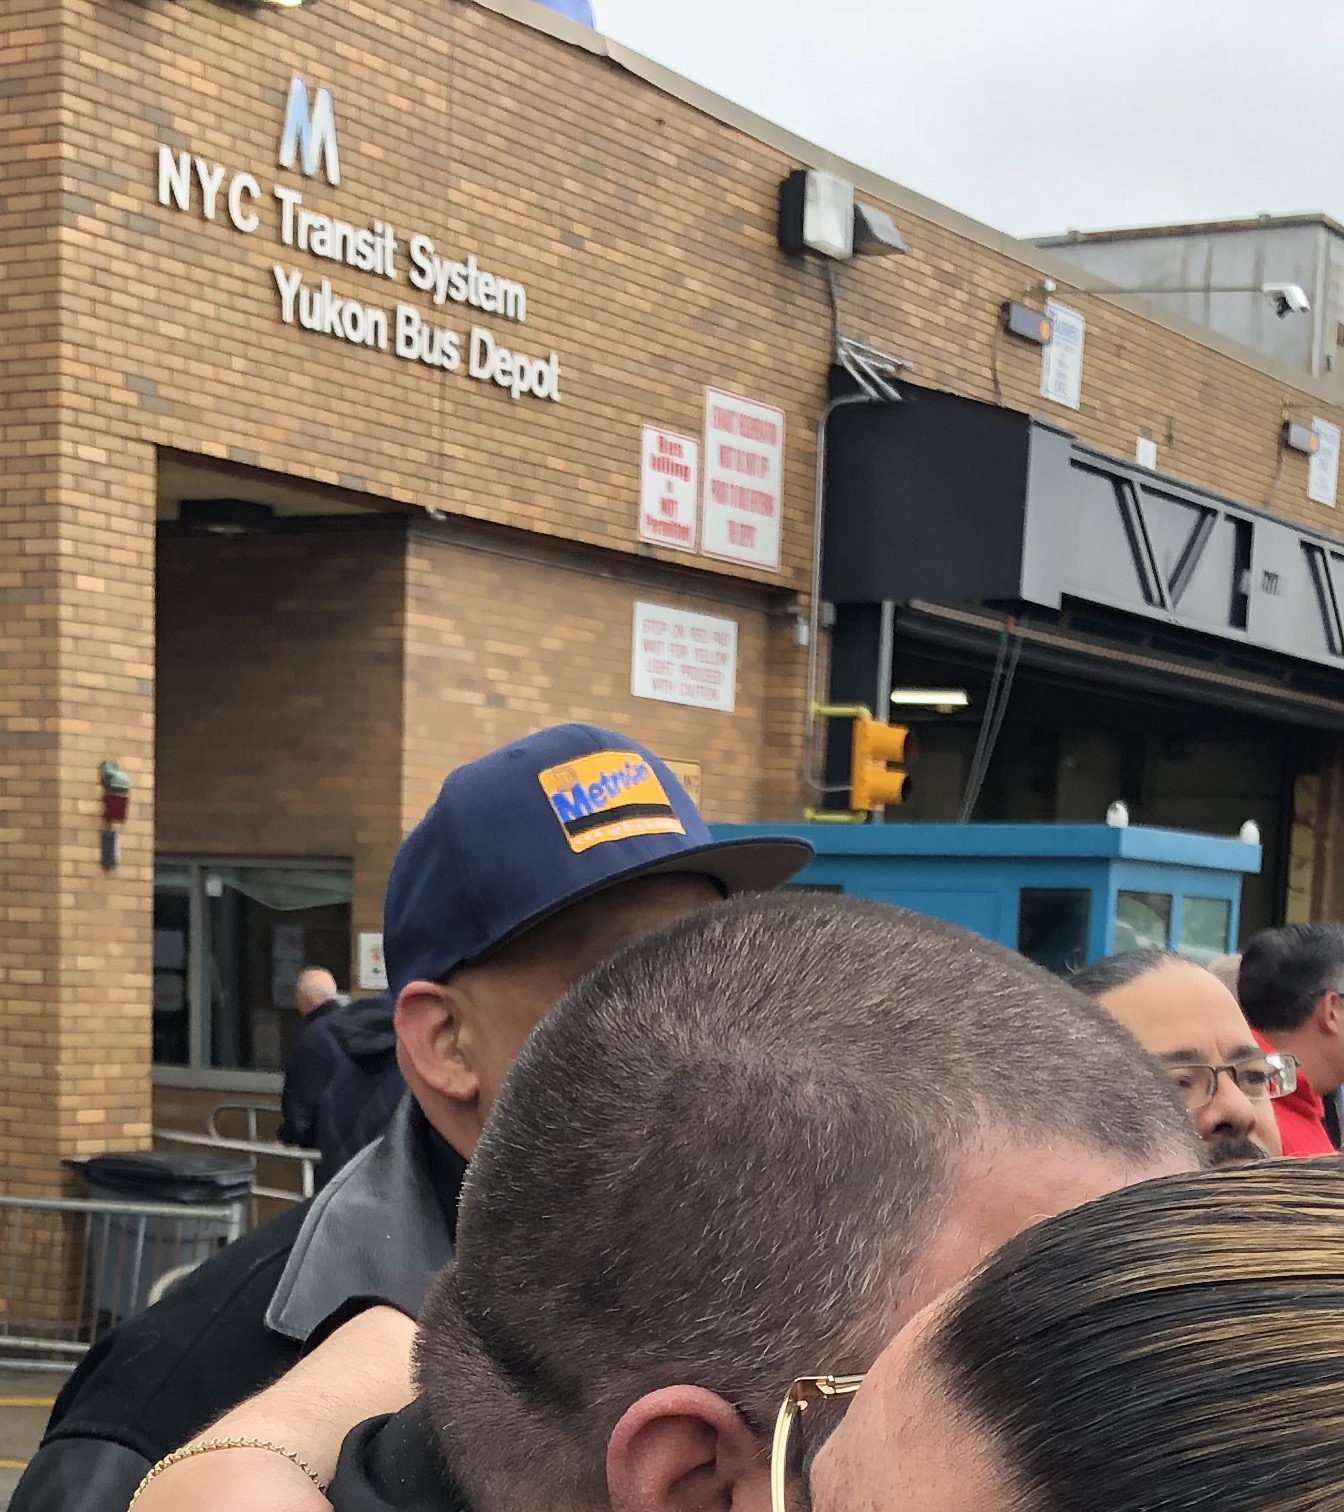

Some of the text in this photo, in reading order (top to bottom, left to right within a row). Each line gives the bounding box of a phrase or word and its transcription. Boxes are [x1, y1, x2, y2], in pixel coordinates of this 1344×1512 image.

[157, 143, 528, 323] NYC Transit System
[273, 264, 562, 401] Yukon Bus Depot
